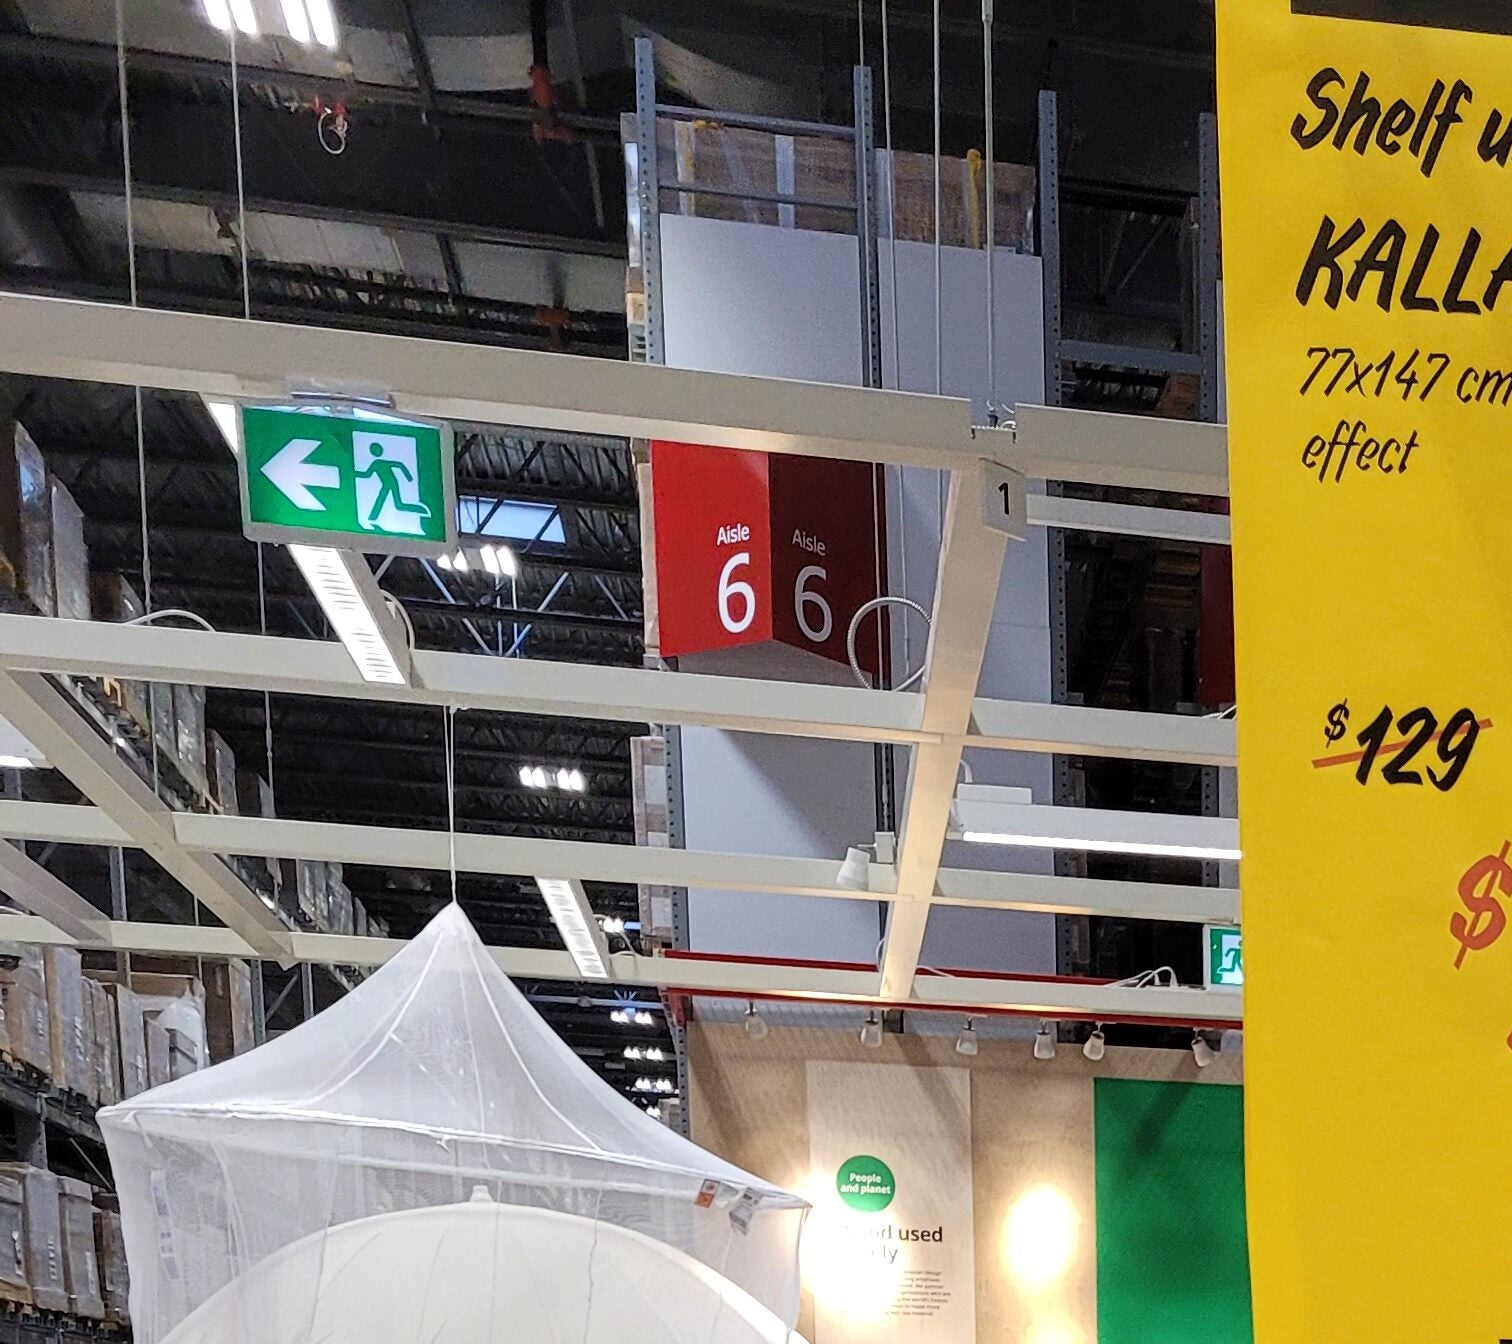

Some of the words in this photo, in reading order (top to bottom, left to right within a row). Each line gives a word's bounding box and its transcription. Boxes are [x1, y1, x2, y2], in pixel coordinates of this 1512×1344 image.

[1292, 67, 1472, 178] Shelf
[1300, 347, 1450, 399] 77x147
[1302, 420, 1419, 482] effect
[716, 523, 750, 546] Aisle
[792, 529, 826, 556] Aisle
[718, 552, 756, 634] 6
[794, 565, 833, 642] 6
[1324, 699, 1481, 791] $129
[840, 1184, 859, 1193] and
[860, 1184, 891, 1195] planet
[849, 1172, 882, 1184] People
[898, 1226, 943, 1243] used
